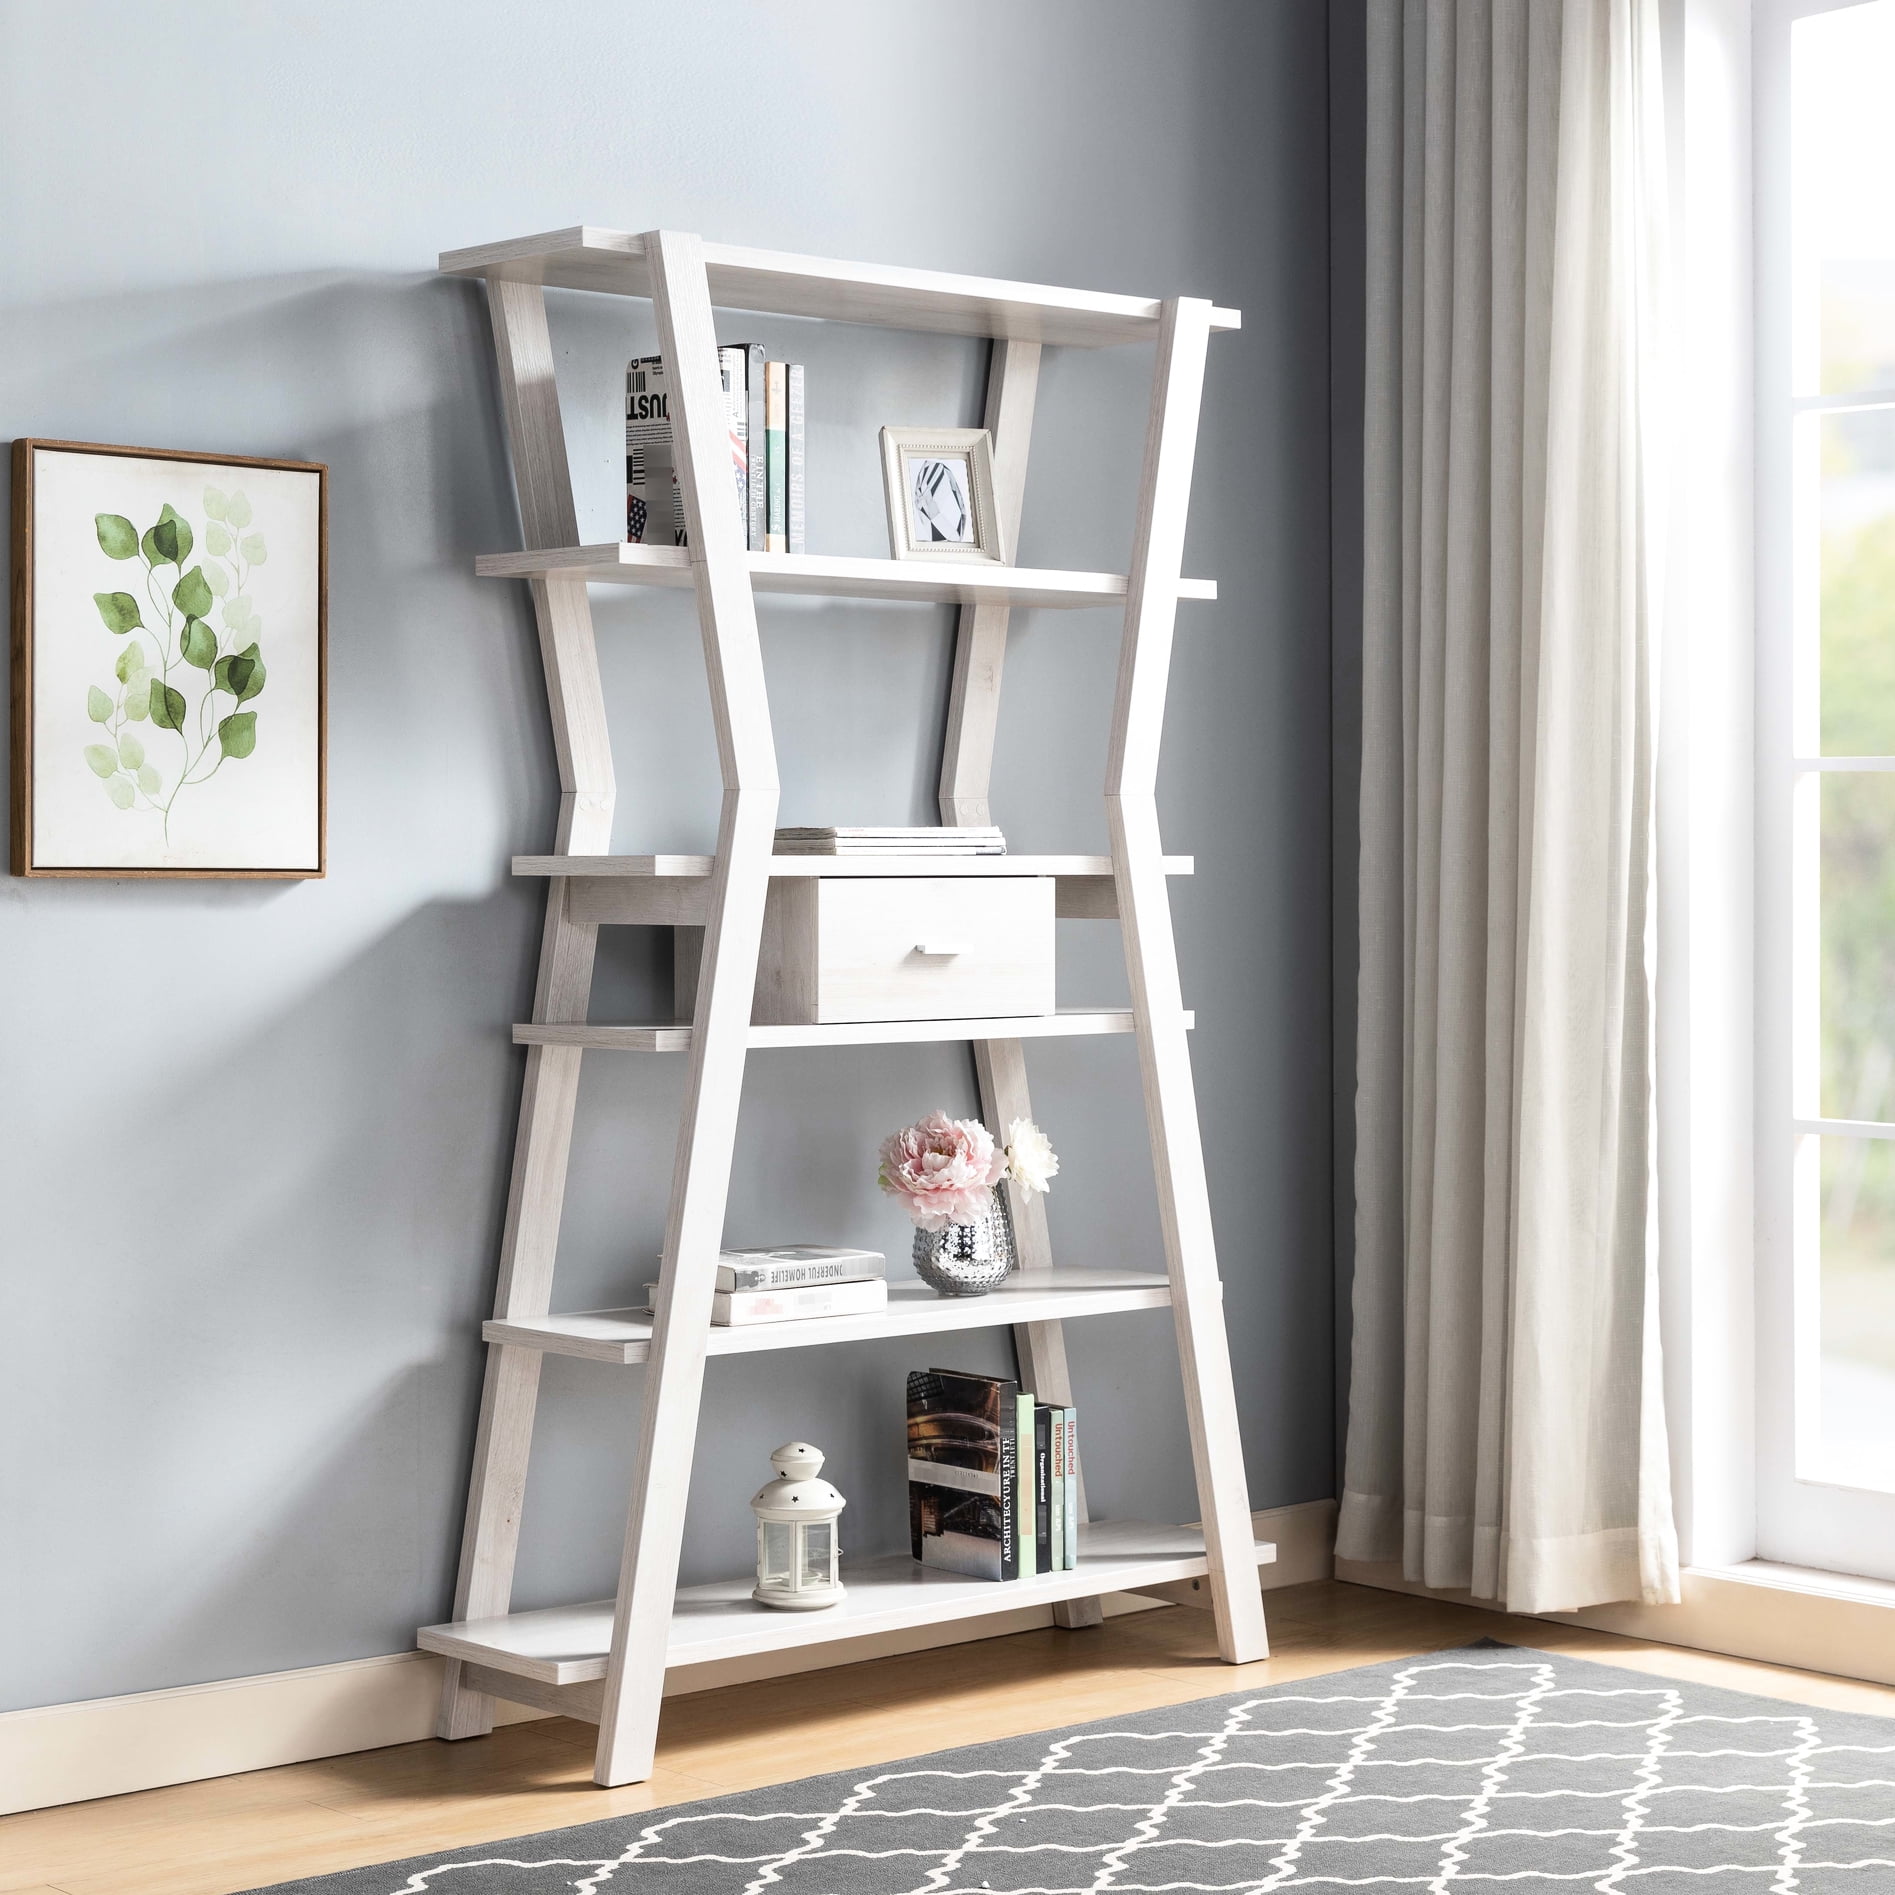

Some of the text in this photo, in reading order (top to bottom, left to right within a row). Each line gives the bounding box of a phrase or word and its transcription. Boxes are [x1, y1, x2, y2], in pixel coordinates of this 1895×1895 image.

[626, 393, 668, 420] JUST
[791, 447, 804, 467] OF
[791, 474, 804, 544] MEMOIRS
[771, 1268, 806, 1283] HOMELIFE
[1002, 1454, 1010, 1468] IN
[1055, 1423, 1063, 1477] Untouched
[1067, 1421, 1075, 1475] Untouched
